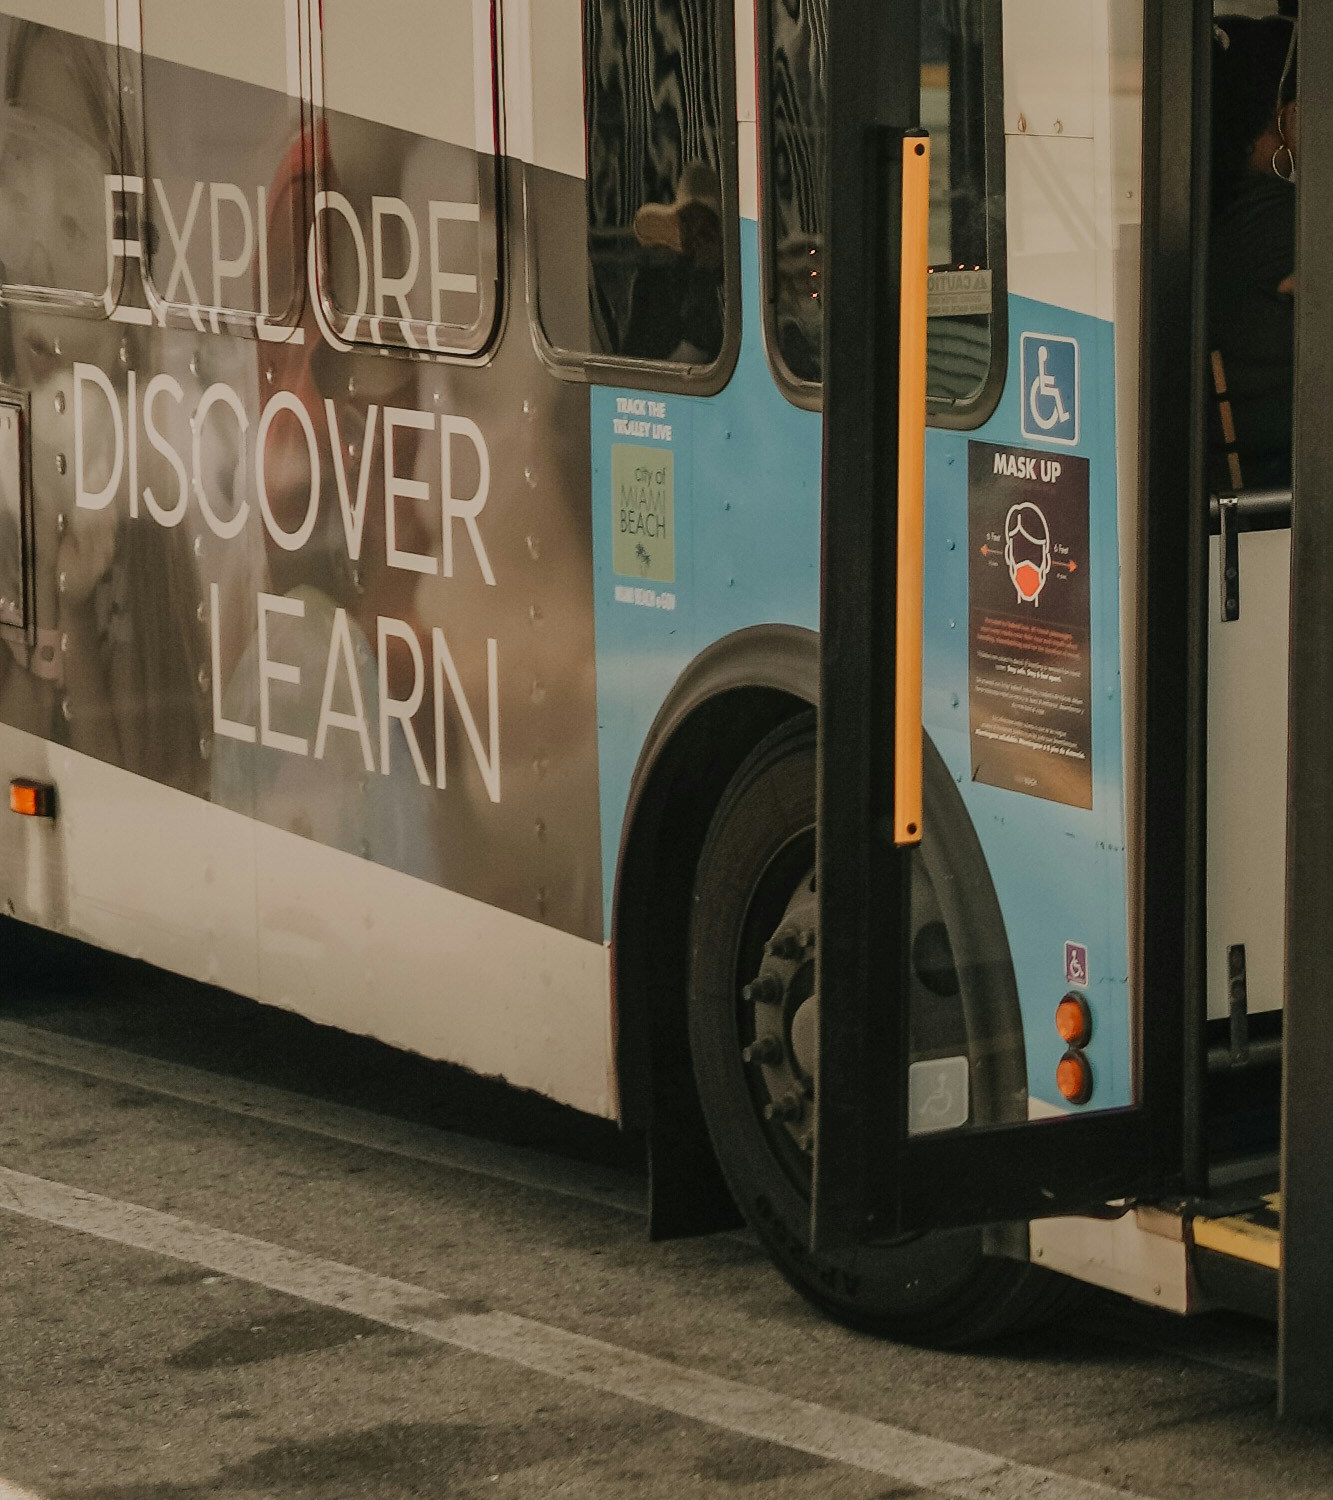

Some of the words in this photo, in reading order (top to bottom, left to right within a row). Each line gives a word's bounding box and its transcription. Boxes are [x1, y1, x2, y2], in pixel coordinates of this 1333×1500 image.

[103, 174, 481, 362] EXPLORE
[647, 401, 666, 419] THE
[73, 361, 497, 586] DISCOVER
[993, 453, 1038, 480] MASK
[1040, 459, 1062, 483] UP
[620, 509, 666, 539] BEACH
[210, 582, 501, 803] LEARN
